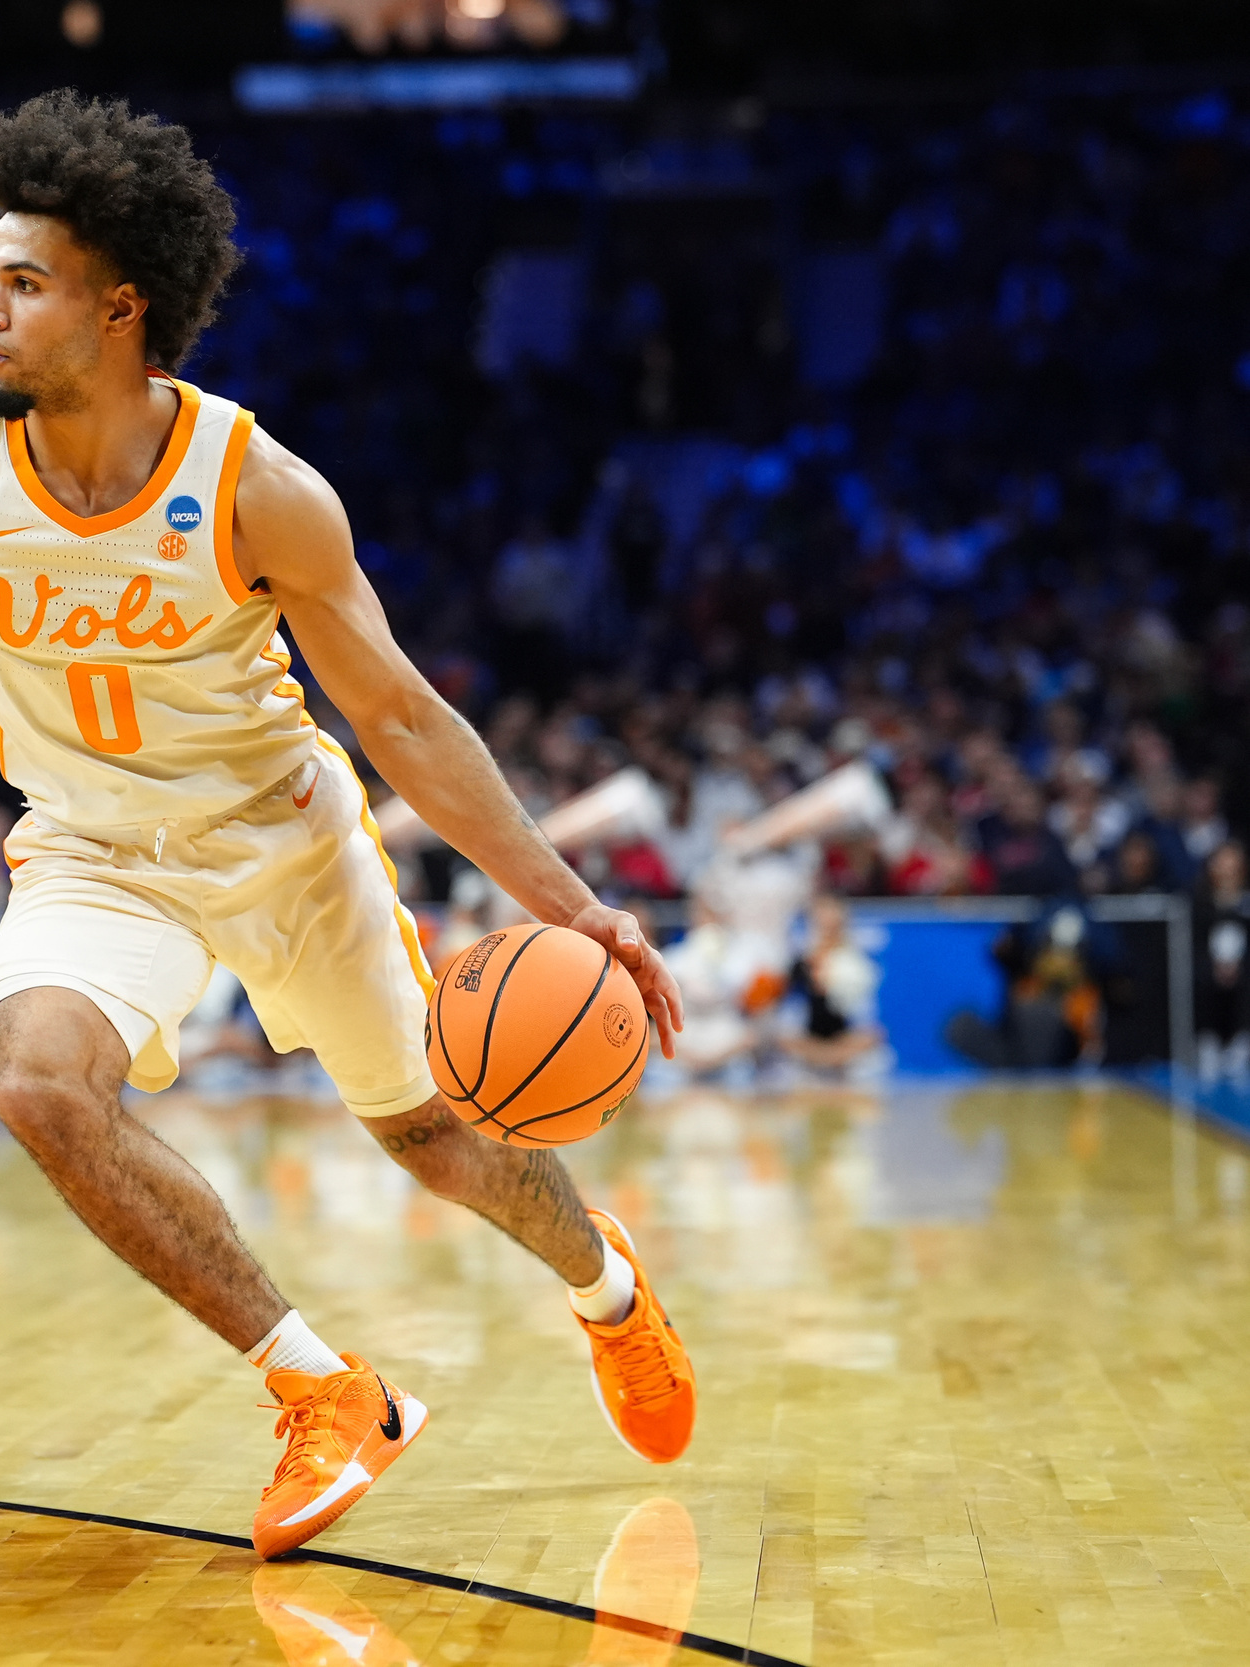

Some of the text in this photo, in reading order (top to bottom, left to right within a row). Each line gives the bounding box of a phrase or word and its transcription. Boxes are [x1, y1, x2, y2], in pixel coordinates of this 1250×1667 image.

[171, 512, 200, 523] NCAA
[160, 534, 185, 559] SEC
[66, 661, 143, 755] 0
[459, 944, 484, 976] MARCH
